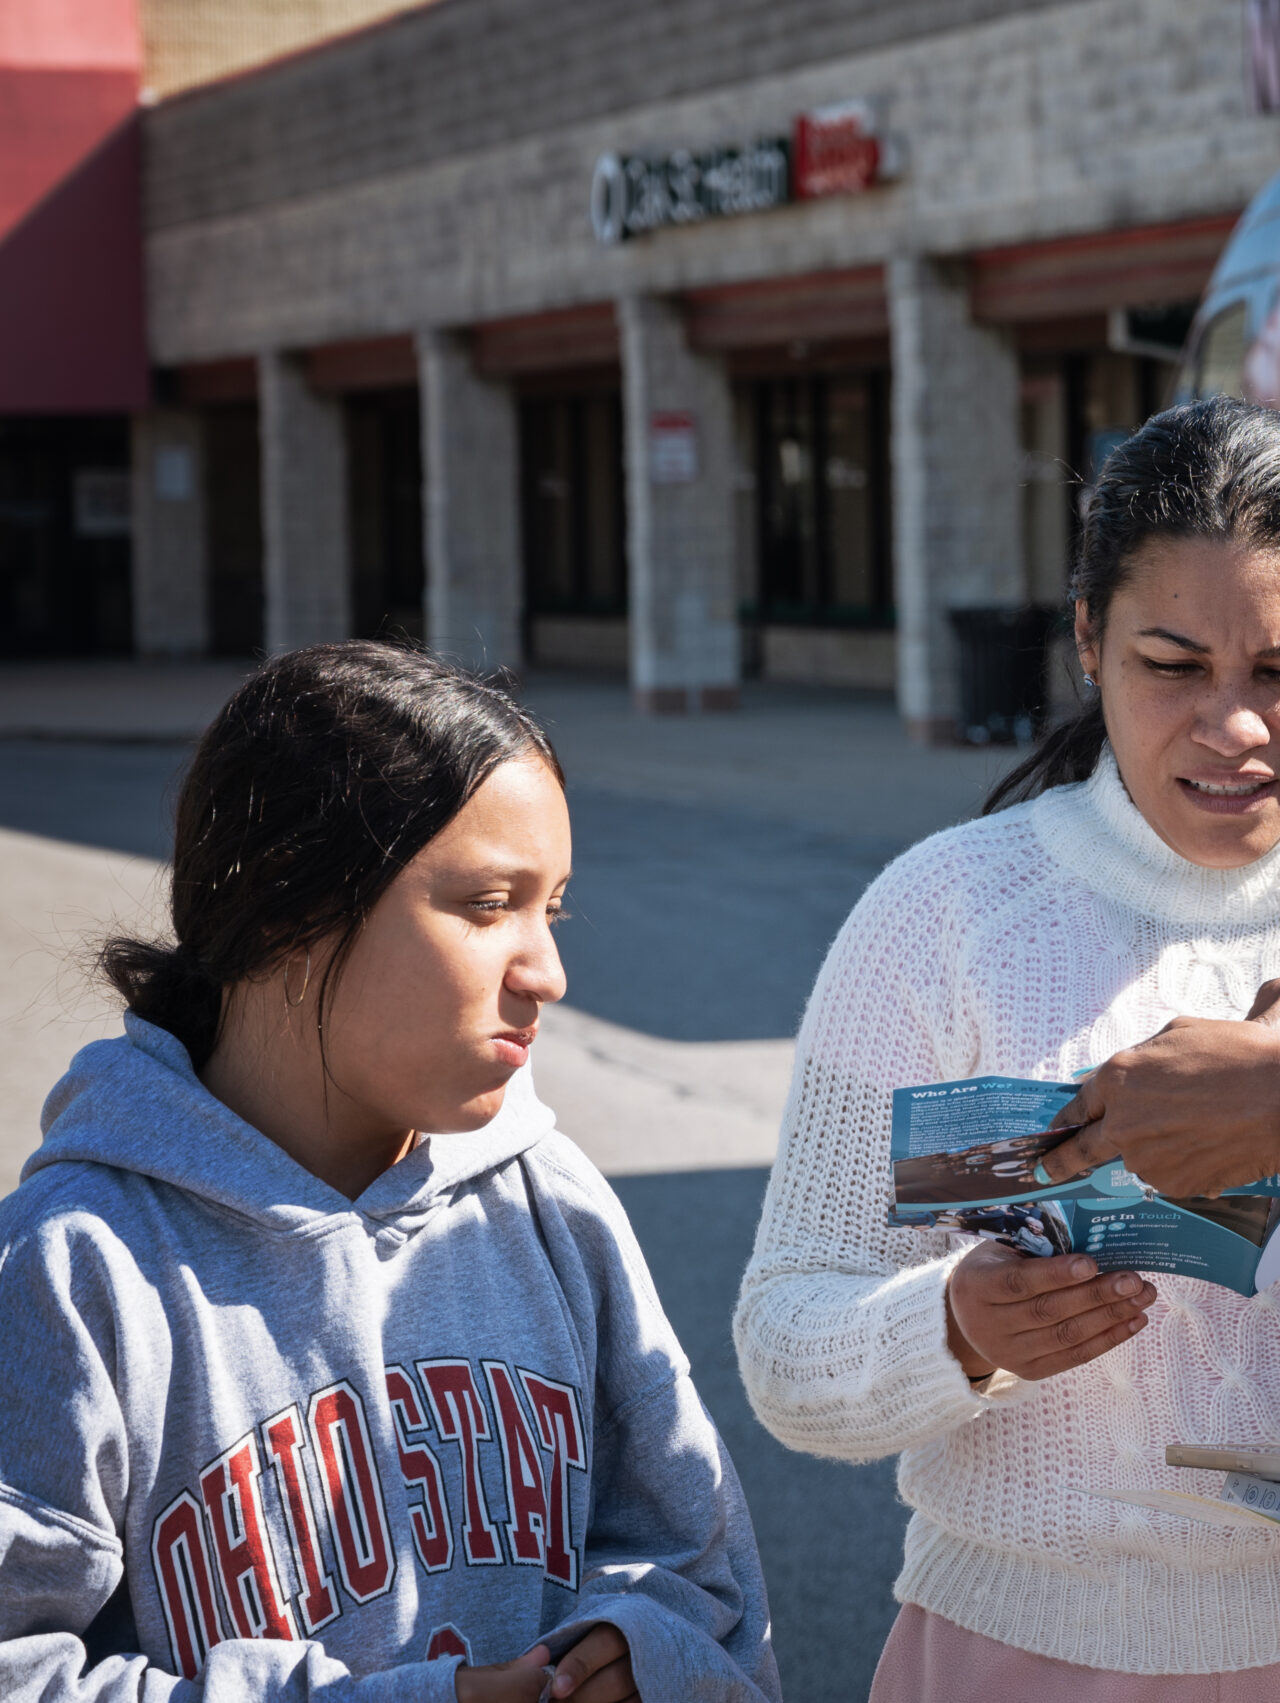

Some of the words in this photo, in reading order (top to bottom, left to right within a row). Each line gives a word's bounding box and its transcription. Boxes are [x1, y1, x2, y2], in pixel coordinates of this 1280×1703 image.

[911, 1090, 948, 1099] Who
[950, 1085, 978, 1094] Are
[981, 1082, 1013, 1090] We?
[1091, 1214, 1116, 1223] Get
[1138, 1212, 1181, 1220] Touch
[151, 1378, 398, 1680] OHIO
[385, 1357, 588, 1593] STAT
